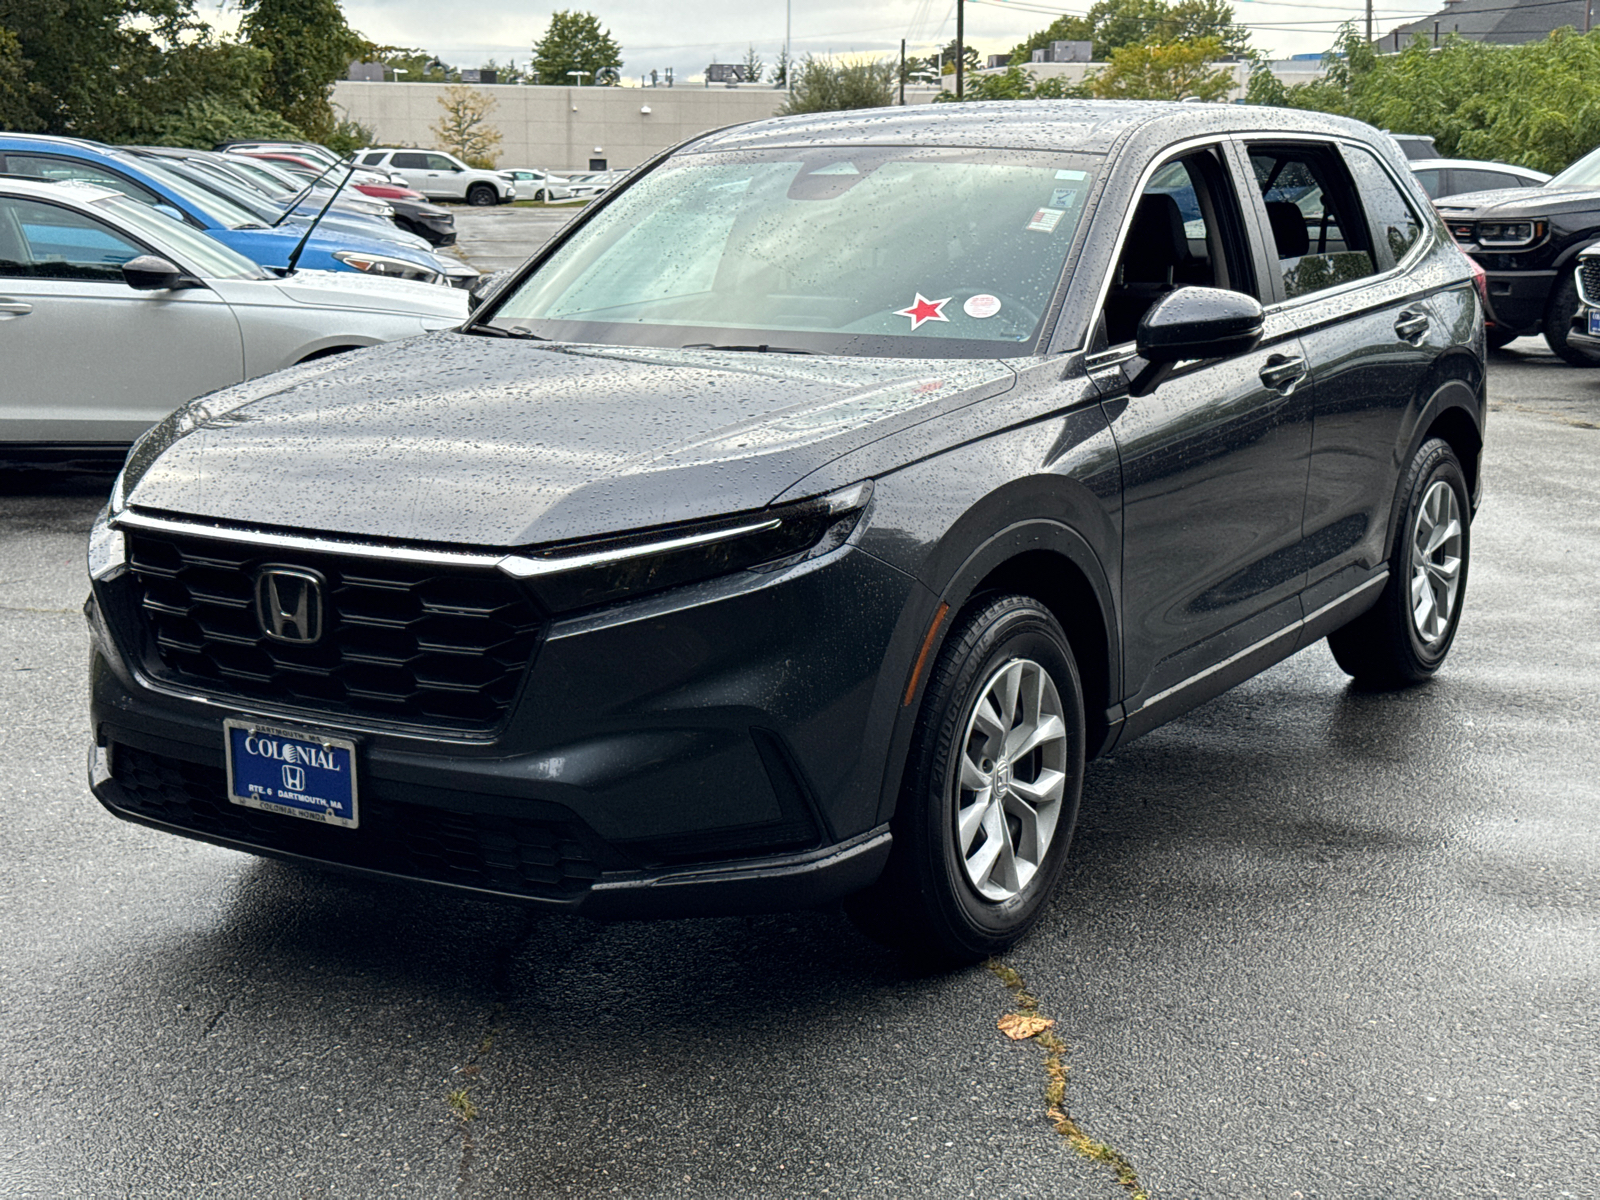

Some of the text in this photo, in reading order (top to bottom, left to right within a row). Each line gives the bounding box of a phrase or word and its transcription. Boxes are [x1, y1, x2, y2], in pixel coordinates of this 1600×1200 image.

[933, 634, 989, 783] BRIDGESTONE
[309, 735, 322, 743] MA
[245, 736, 340, 771] COLONIAL
[267, 787, 272, 795] 6
[278, 790, 329, 808] DARTMOUTH,
[330, 800, 343, 809] MA
[260, 801, 326, 822] COLONIAL HONDA
